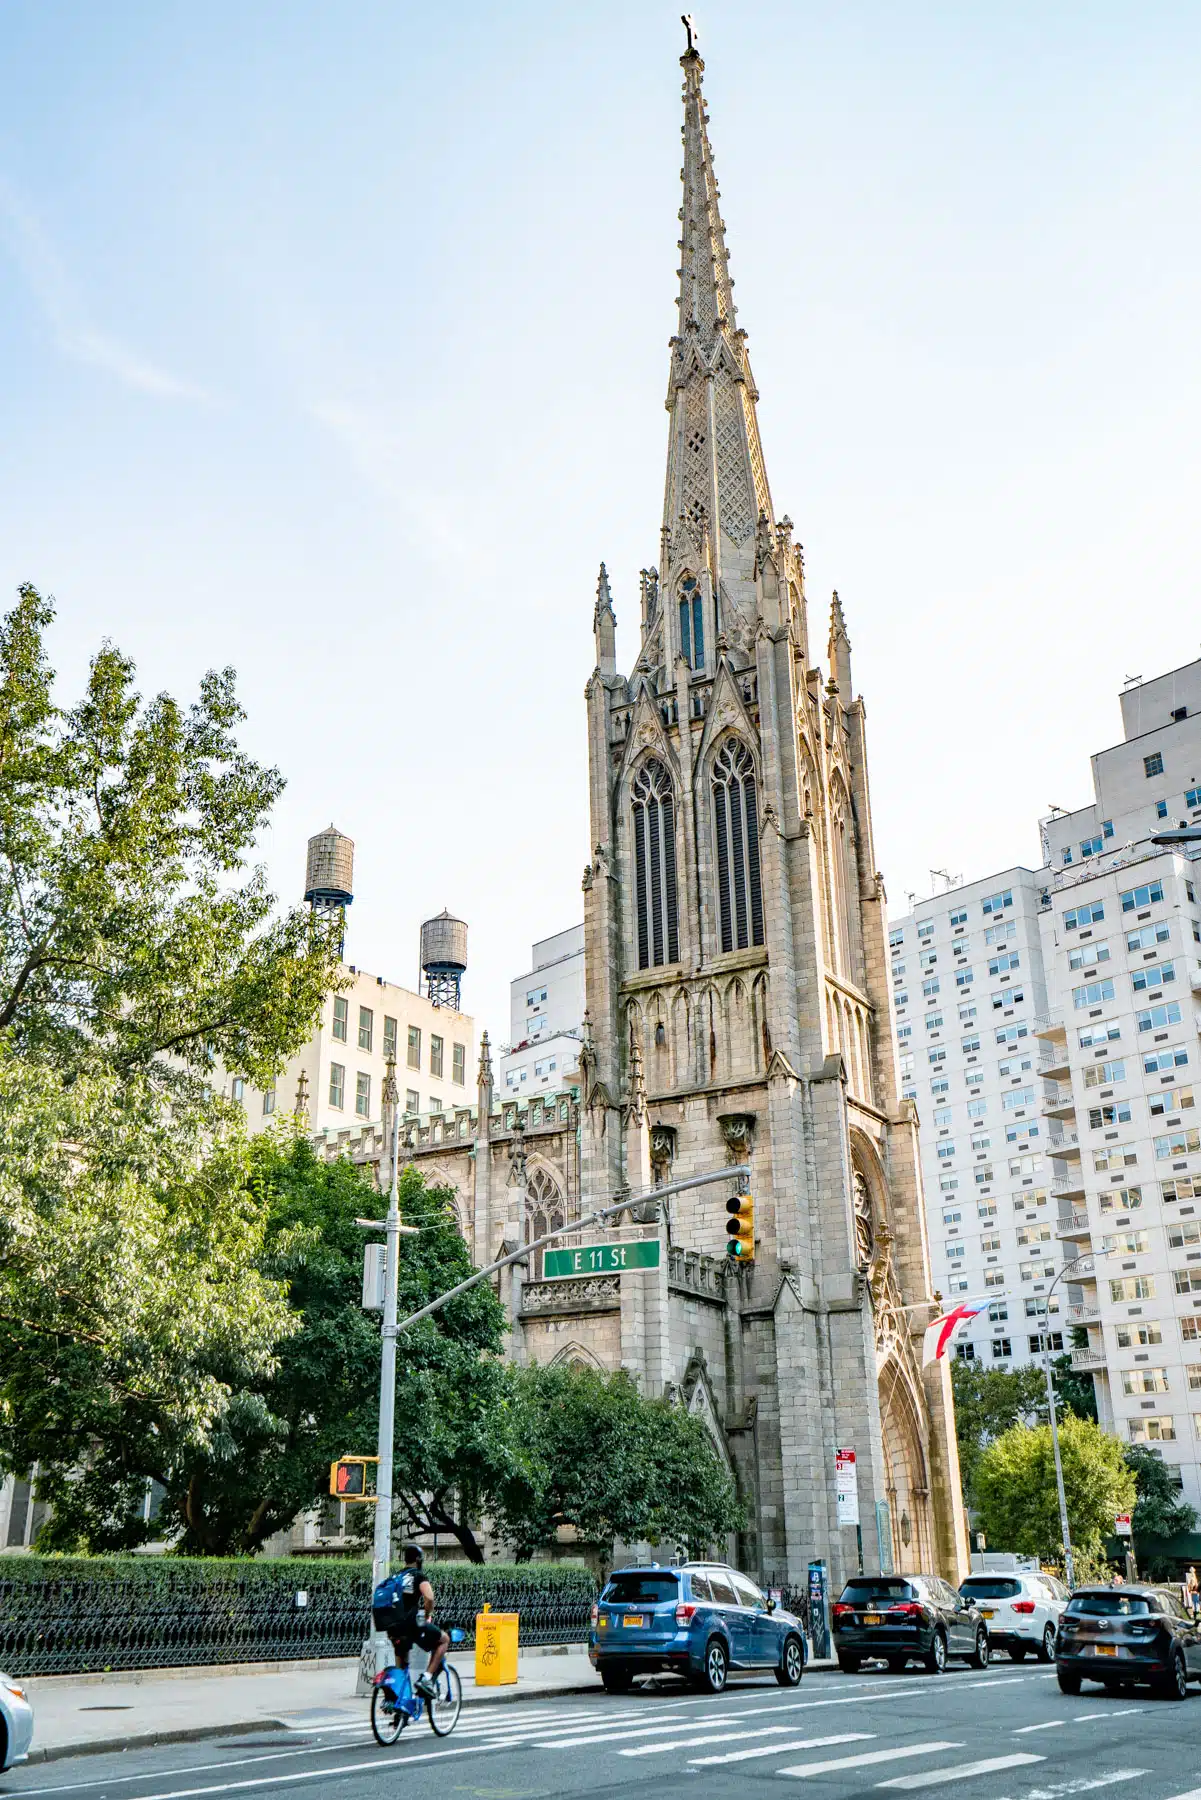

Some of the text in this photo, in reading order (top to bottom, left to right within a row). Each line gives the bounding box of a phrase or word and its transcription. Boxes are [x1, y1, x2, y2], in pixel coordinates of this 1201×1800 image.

[575, 1248, 626, 1270] E 11 St
